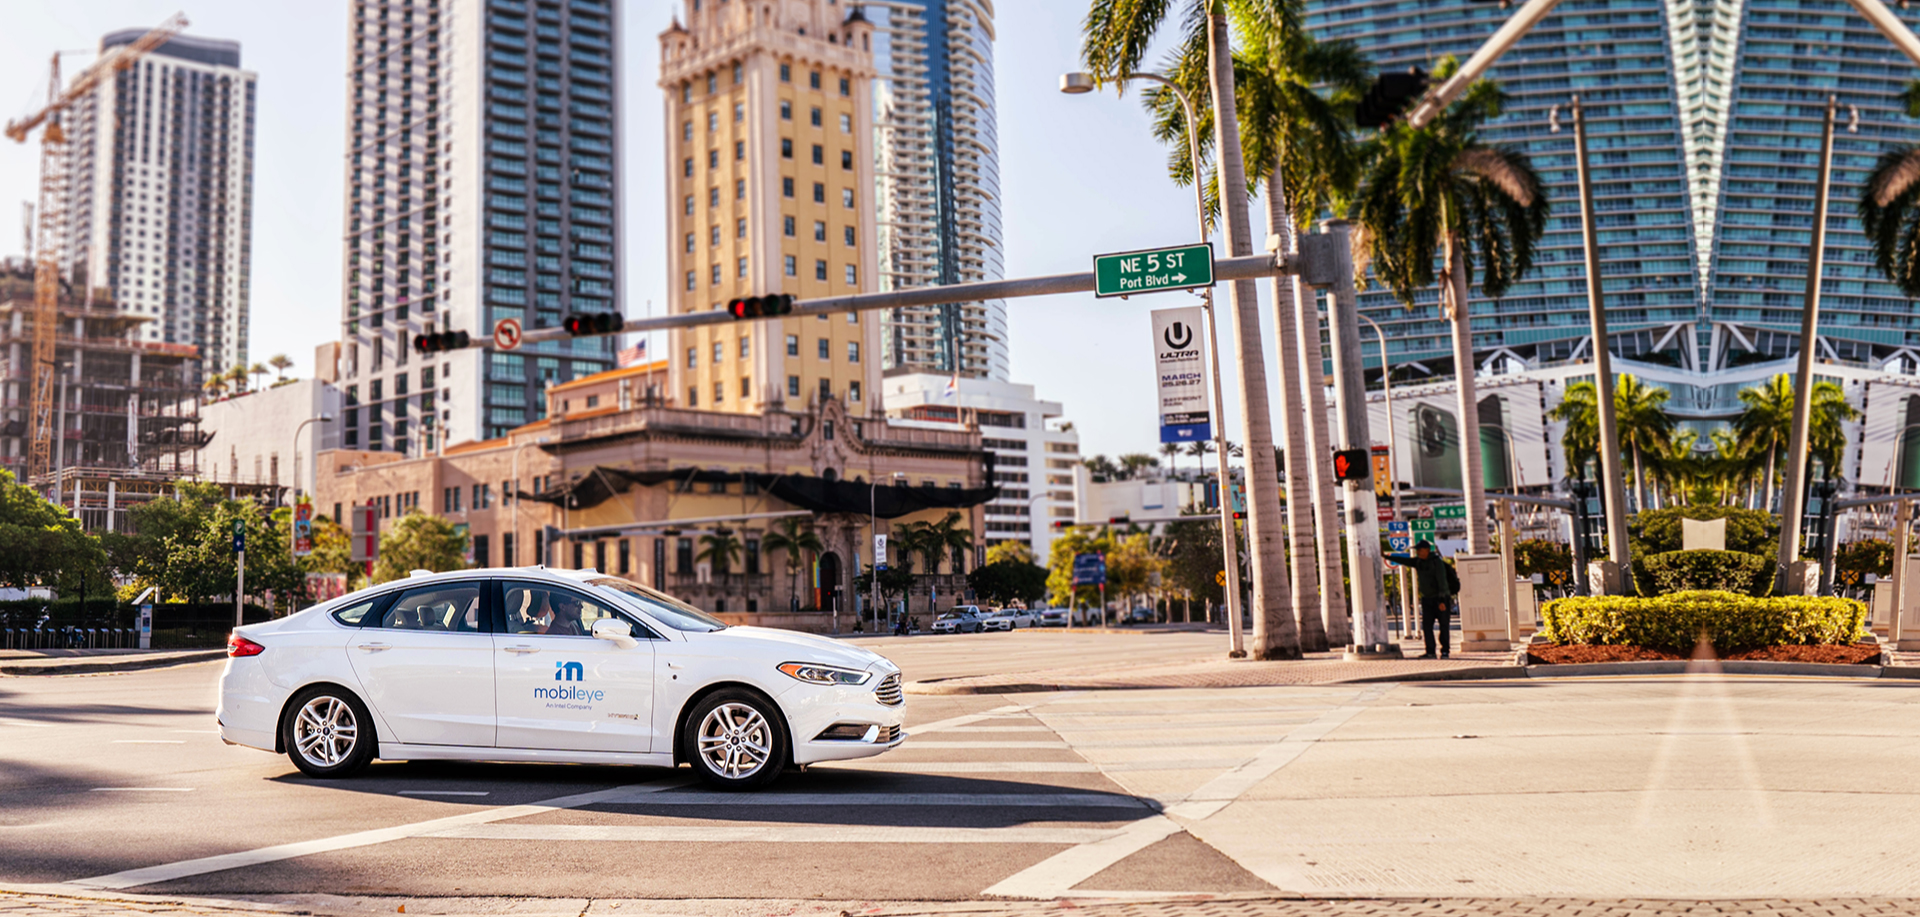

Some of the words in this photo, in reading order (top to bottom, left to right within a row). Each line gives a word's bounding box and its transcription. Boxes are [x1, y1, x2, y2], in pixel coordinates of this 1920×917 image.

[1120, 257, 1141, 273] NE
[1147, 254, 1160, 272] 5
[1166, 252, 1185, 268] ST
[1120, 276, 1142, 289] Port
[1145, 273, 1169, 286] Blvd
[1160, 350, 1199, 359] ULTRA
[1162, 372, 1201, 381] MARCH
[1416, 521, 1430, 529] TO
[1392, 538, 1407, 550] 95
[534, 685, 604, 704] mobileye
[566, 703, 592, 711] Company
